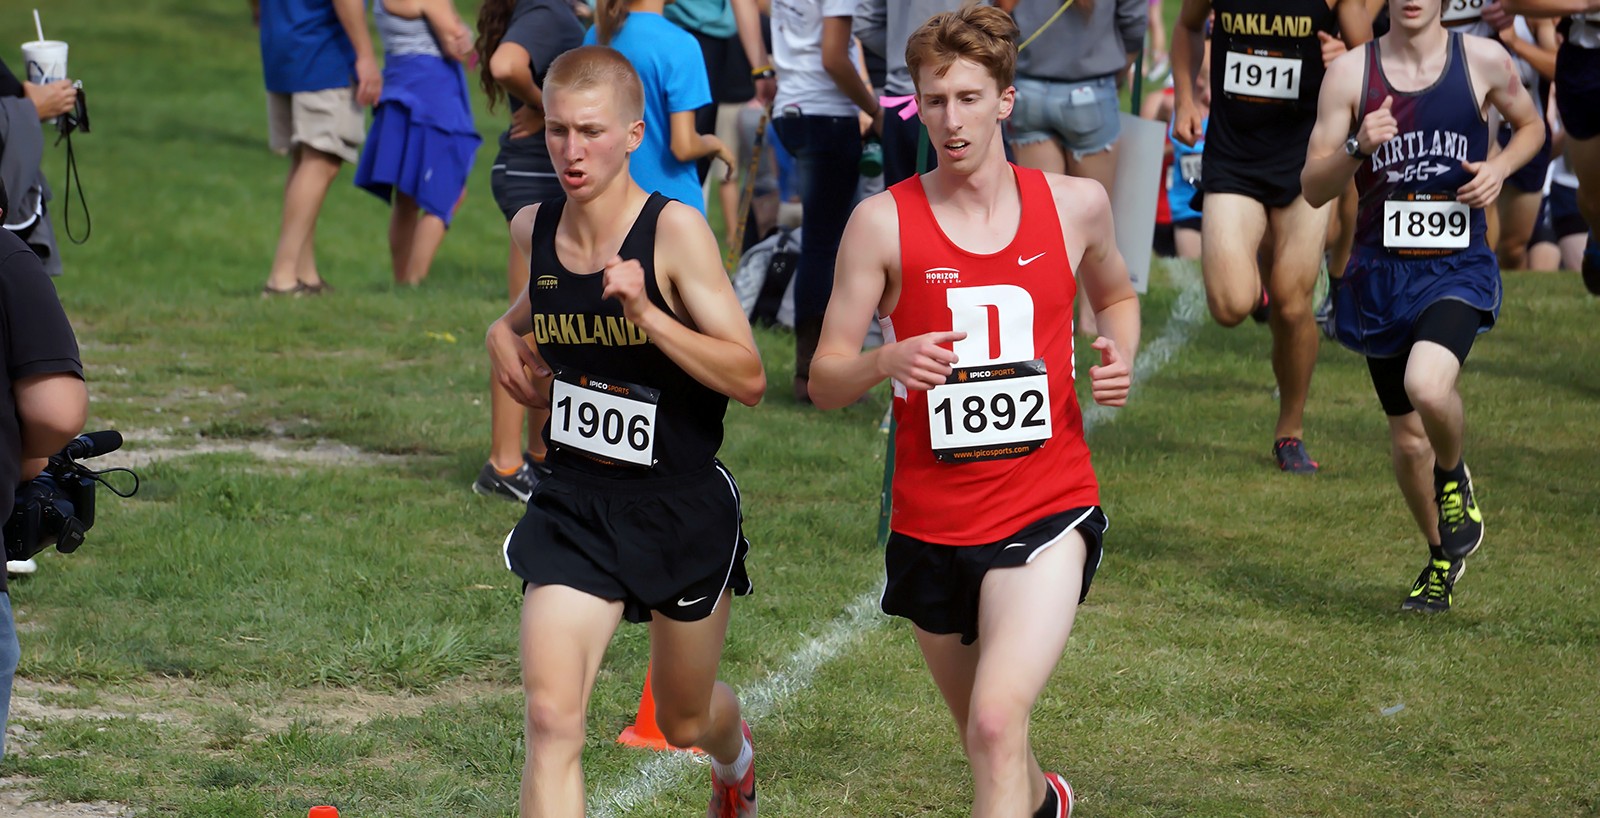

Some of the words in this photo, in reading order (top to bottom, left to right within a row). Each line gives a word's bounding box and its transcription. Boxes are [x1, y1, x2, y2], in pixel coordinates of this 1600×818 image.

[1221, 12, 1312, 37] OAKLAND
[1230, 62, 1294, 90] 1911
[1371, 129, 1468, 172] KIRTLAND
[1388, 210, 1467, 238] 1899
[925, 272, 959, 280] HORIZON
[533, 313, 648, 346] OAKLAND
[946, 284, 1034, 369] D
[557, 395, 651, 452] 1906
[934, 389, 1046, 435] 1892
[953, 445, 1030, 459] www.ipicosports.com
